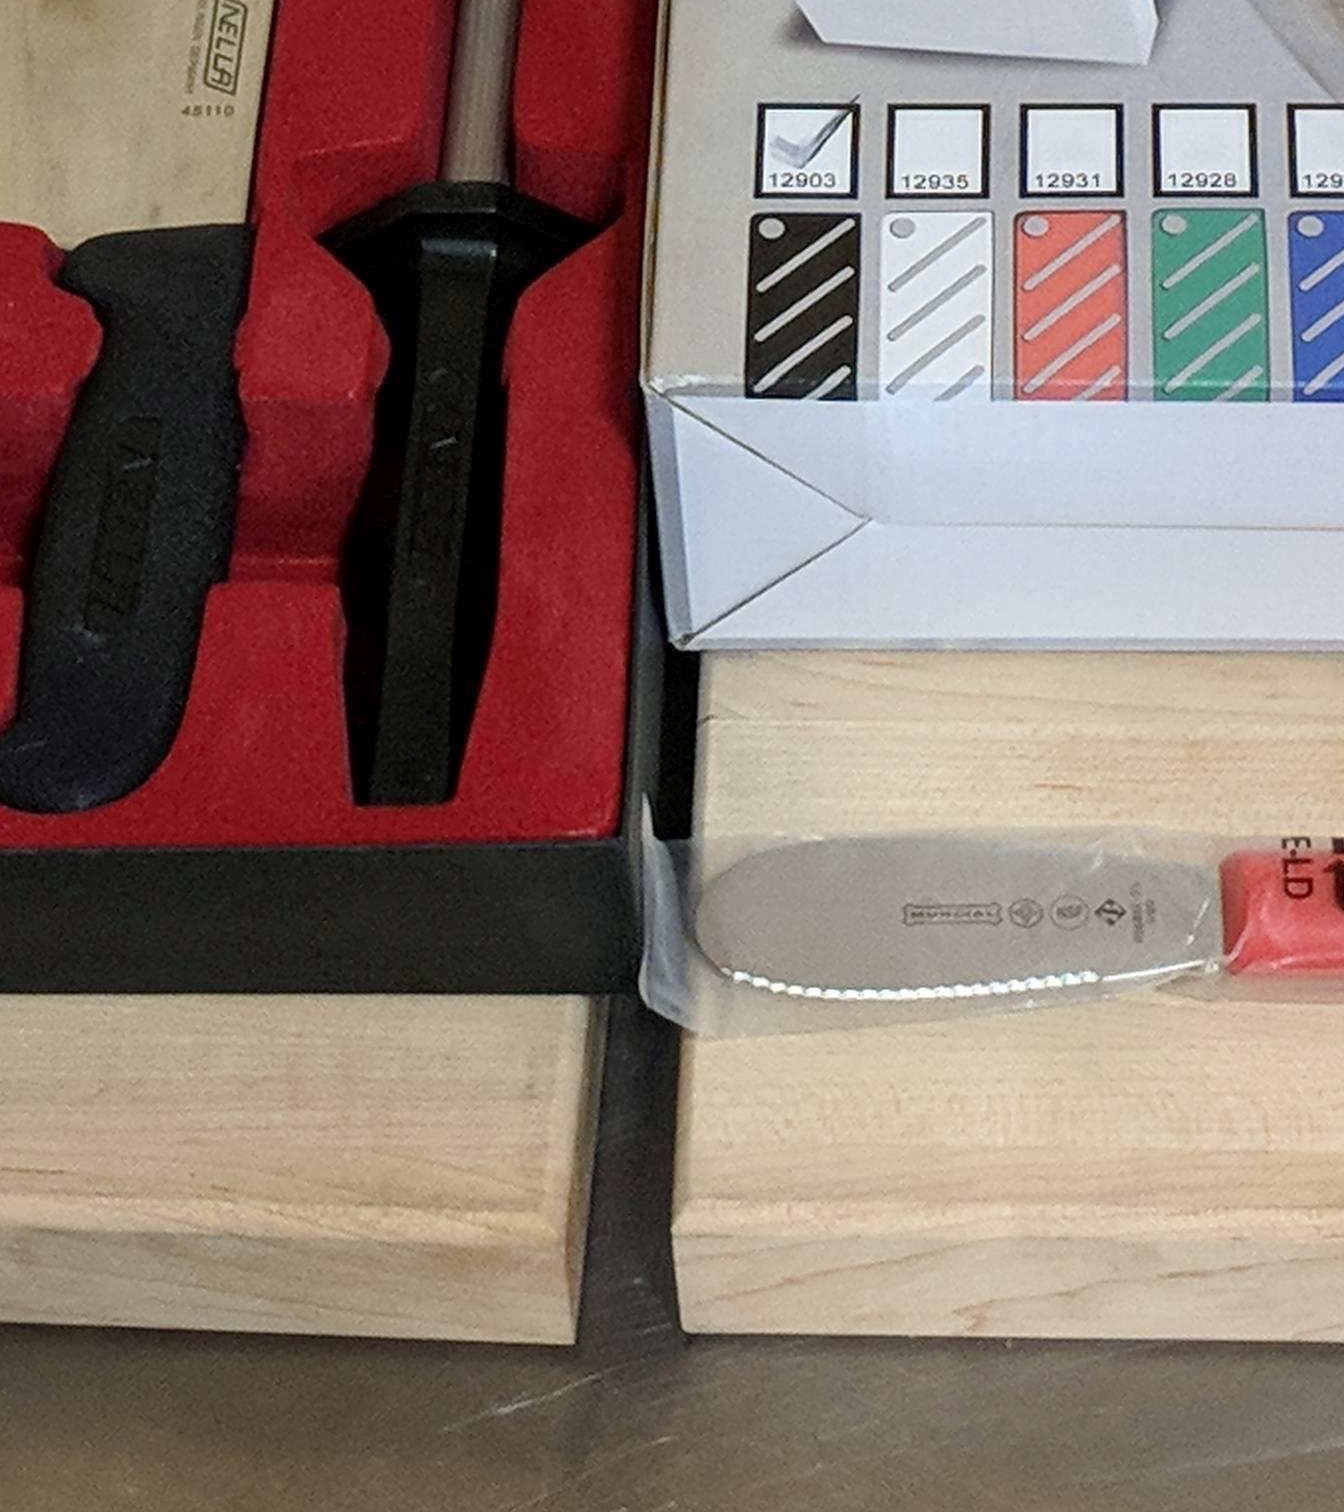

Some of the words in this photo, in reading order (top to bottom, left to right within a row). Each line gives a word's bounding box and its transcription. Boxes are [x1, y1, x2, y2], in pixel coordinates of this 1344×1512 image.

[211, 1, 241, 87] NELLA
[768, 171, 837, 189] 12903
[901, 174, 969, 191] 12935
[1035, 172, 1102, 189] 12931
[1167, 172, 1237, 189] 12928
[1281, 835, 1313, 900] E-LD
